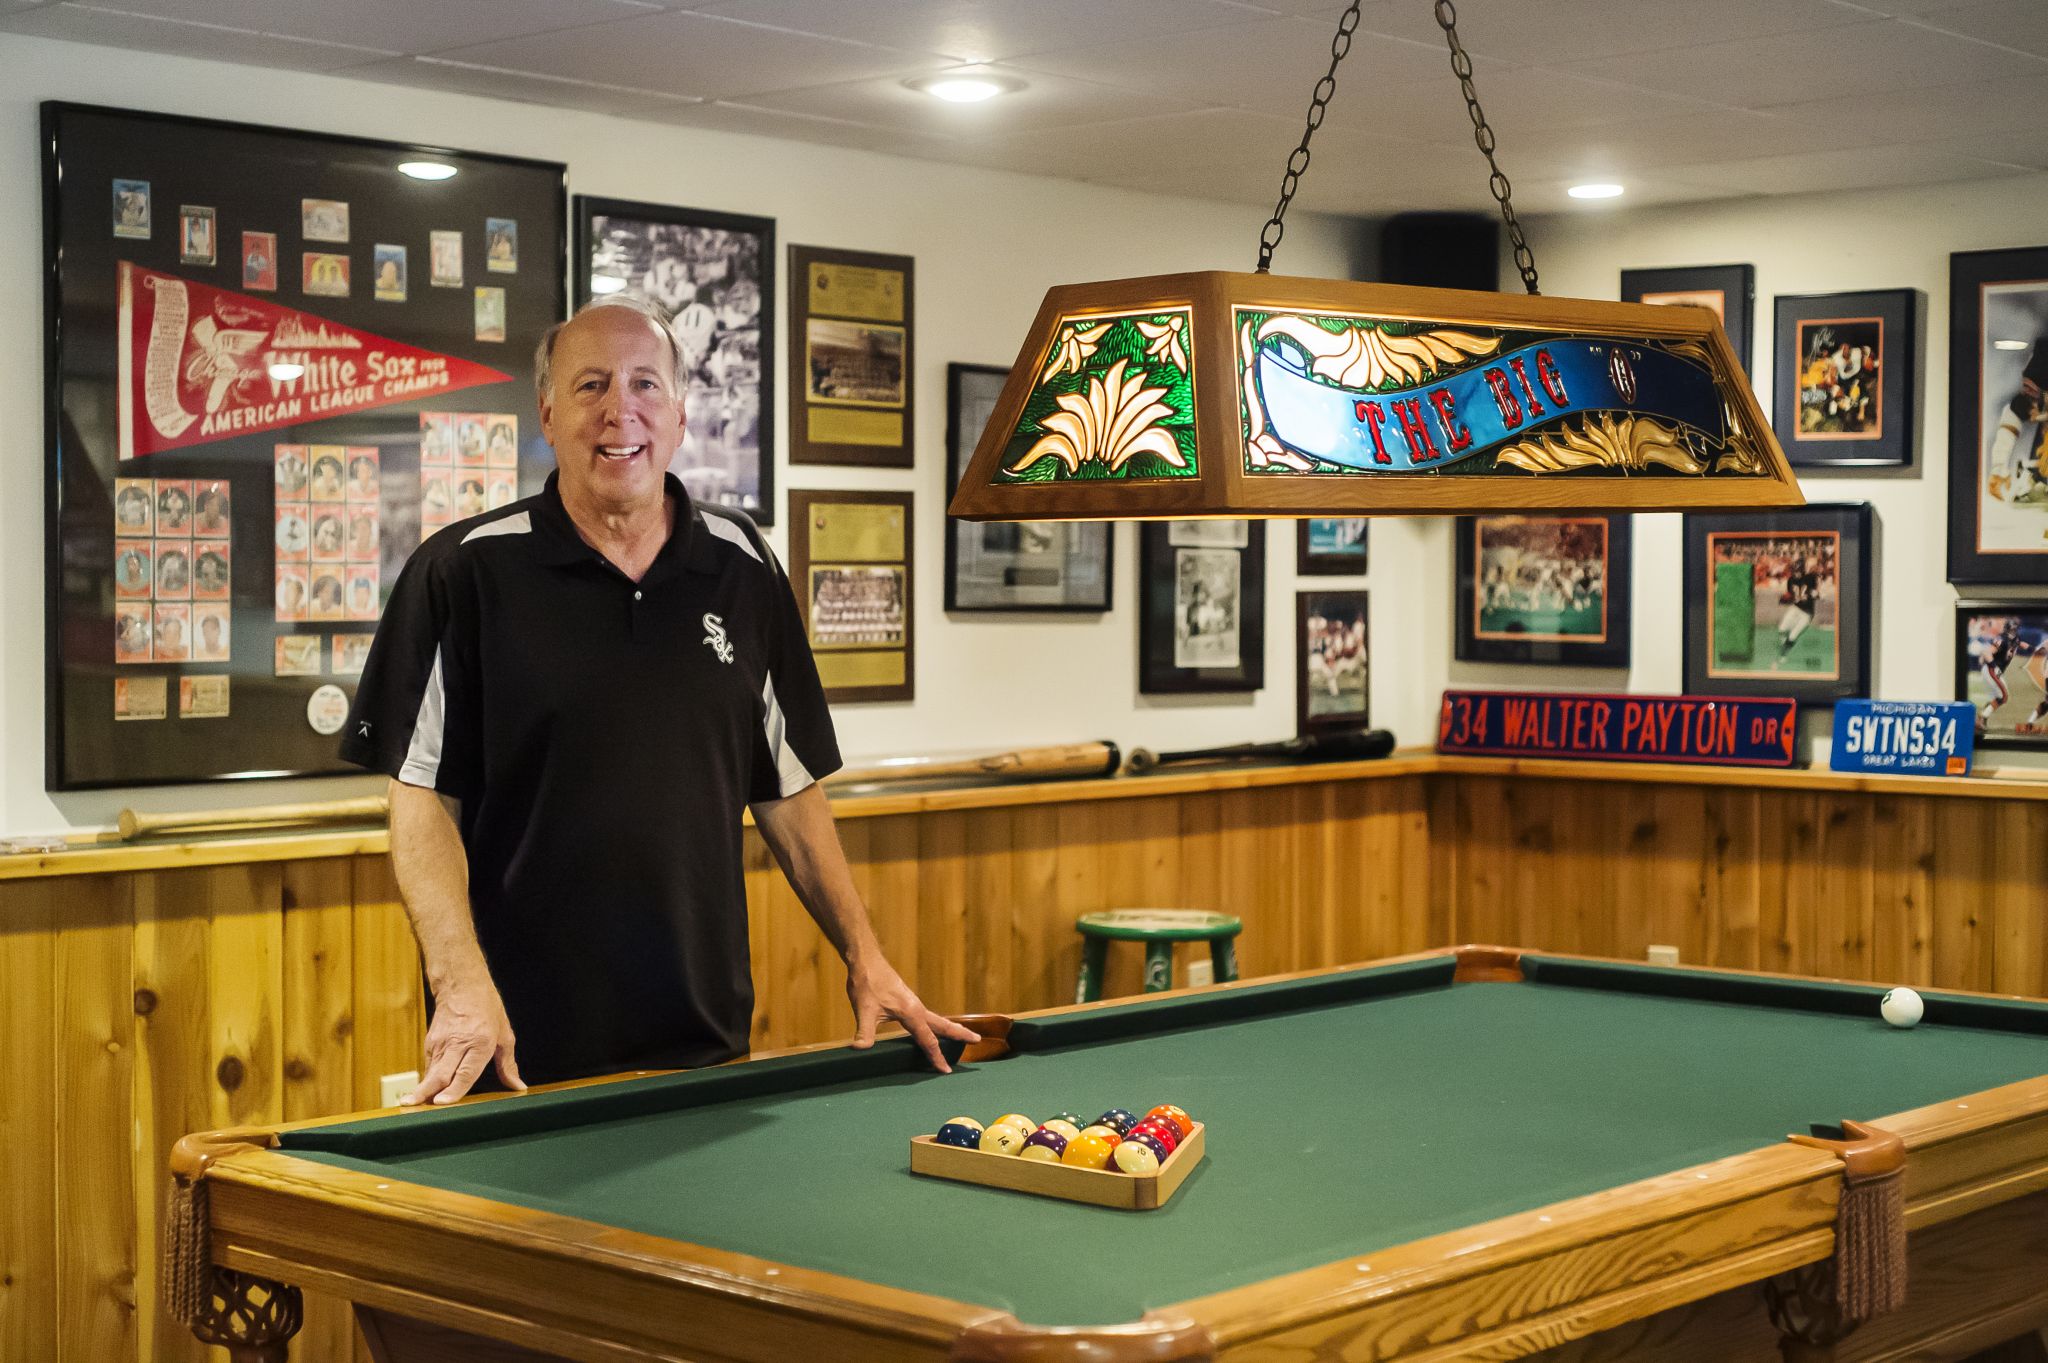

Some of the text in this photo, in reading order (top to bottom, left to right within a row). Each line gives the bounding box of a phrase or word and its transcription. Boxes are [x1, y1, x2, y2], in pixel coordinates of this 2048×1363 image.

[263, 351, 357, 399] White
[201, 370, 449, 437] AMERICAN LEAGUE CHAMPS
[1353, 386, 1473, 465] THE
[1484, 348, 1570, 431] BIG
[1453, 698, 1778, 755] 34 WALTER PAYTON DR
[1871, 703, 1937, 715] MICHIGAN
[1846, 715, 1957, 756] SWTNS34
[1862, 754, 1897, 768] GREAT
[1902, 755, 1936, 769] LAKES
